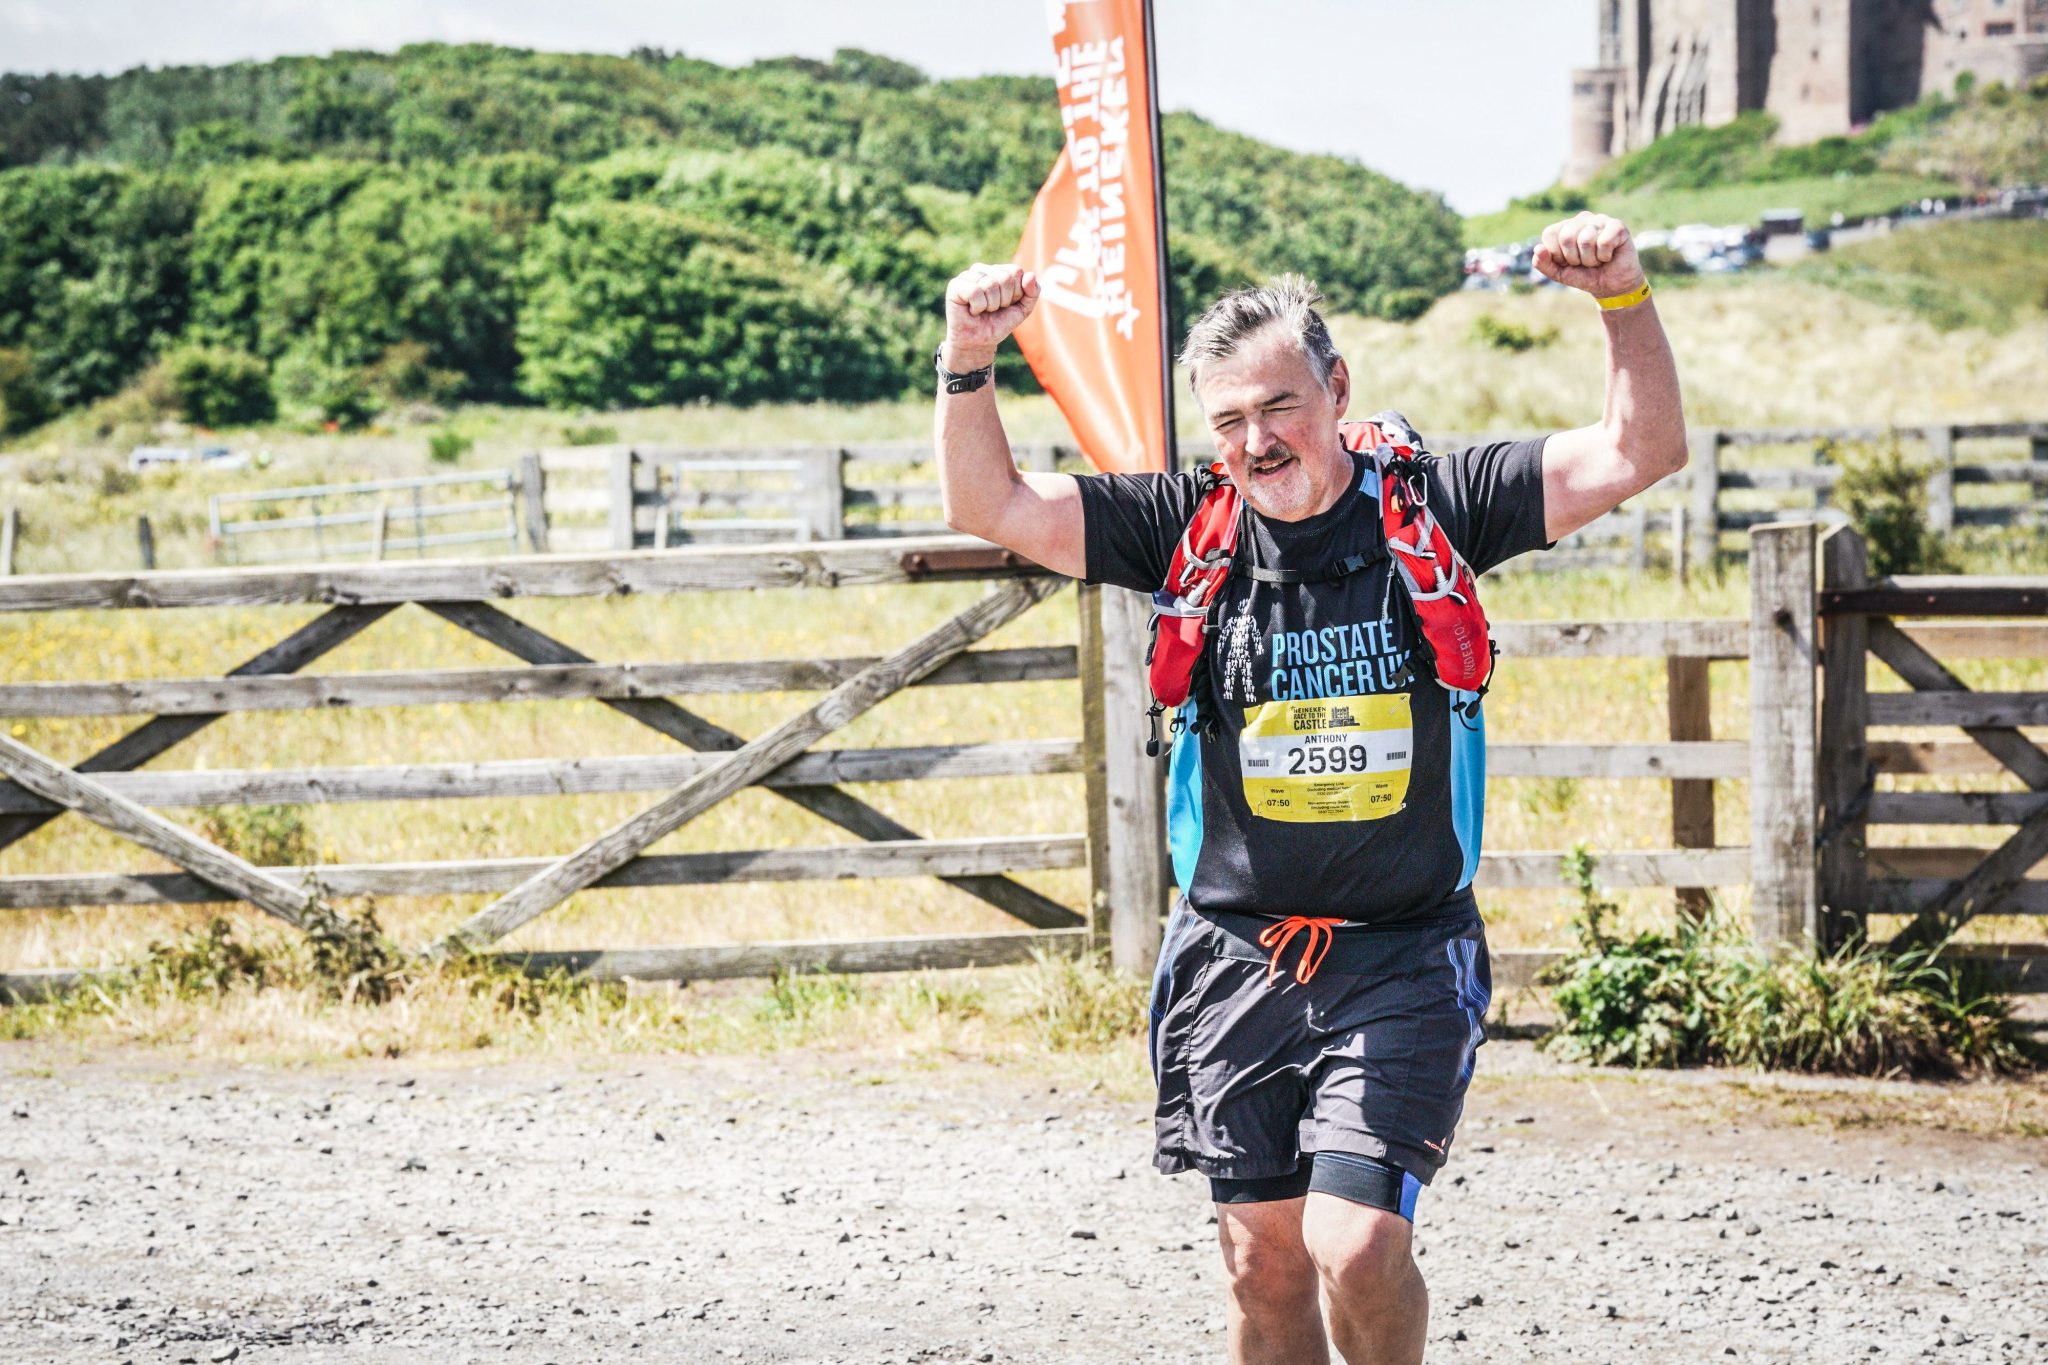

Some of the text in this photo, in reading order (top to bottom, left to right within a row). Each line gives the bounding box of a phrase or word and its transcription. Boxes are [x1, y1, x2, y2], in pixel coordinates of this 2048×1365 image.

[1272, 619, 1397, 668] PROSTATE
[1271, 659, 1377, 700] CANCER
[1294, 719, 1327, 730] CASTLE
[1304, 733, 1348, 745] ANTHONY
[1287, 744, 1368, 775] 2599
[1266, 799, 1290, 807] 07:50
[1370, 793, 1392, 803] 07:50
